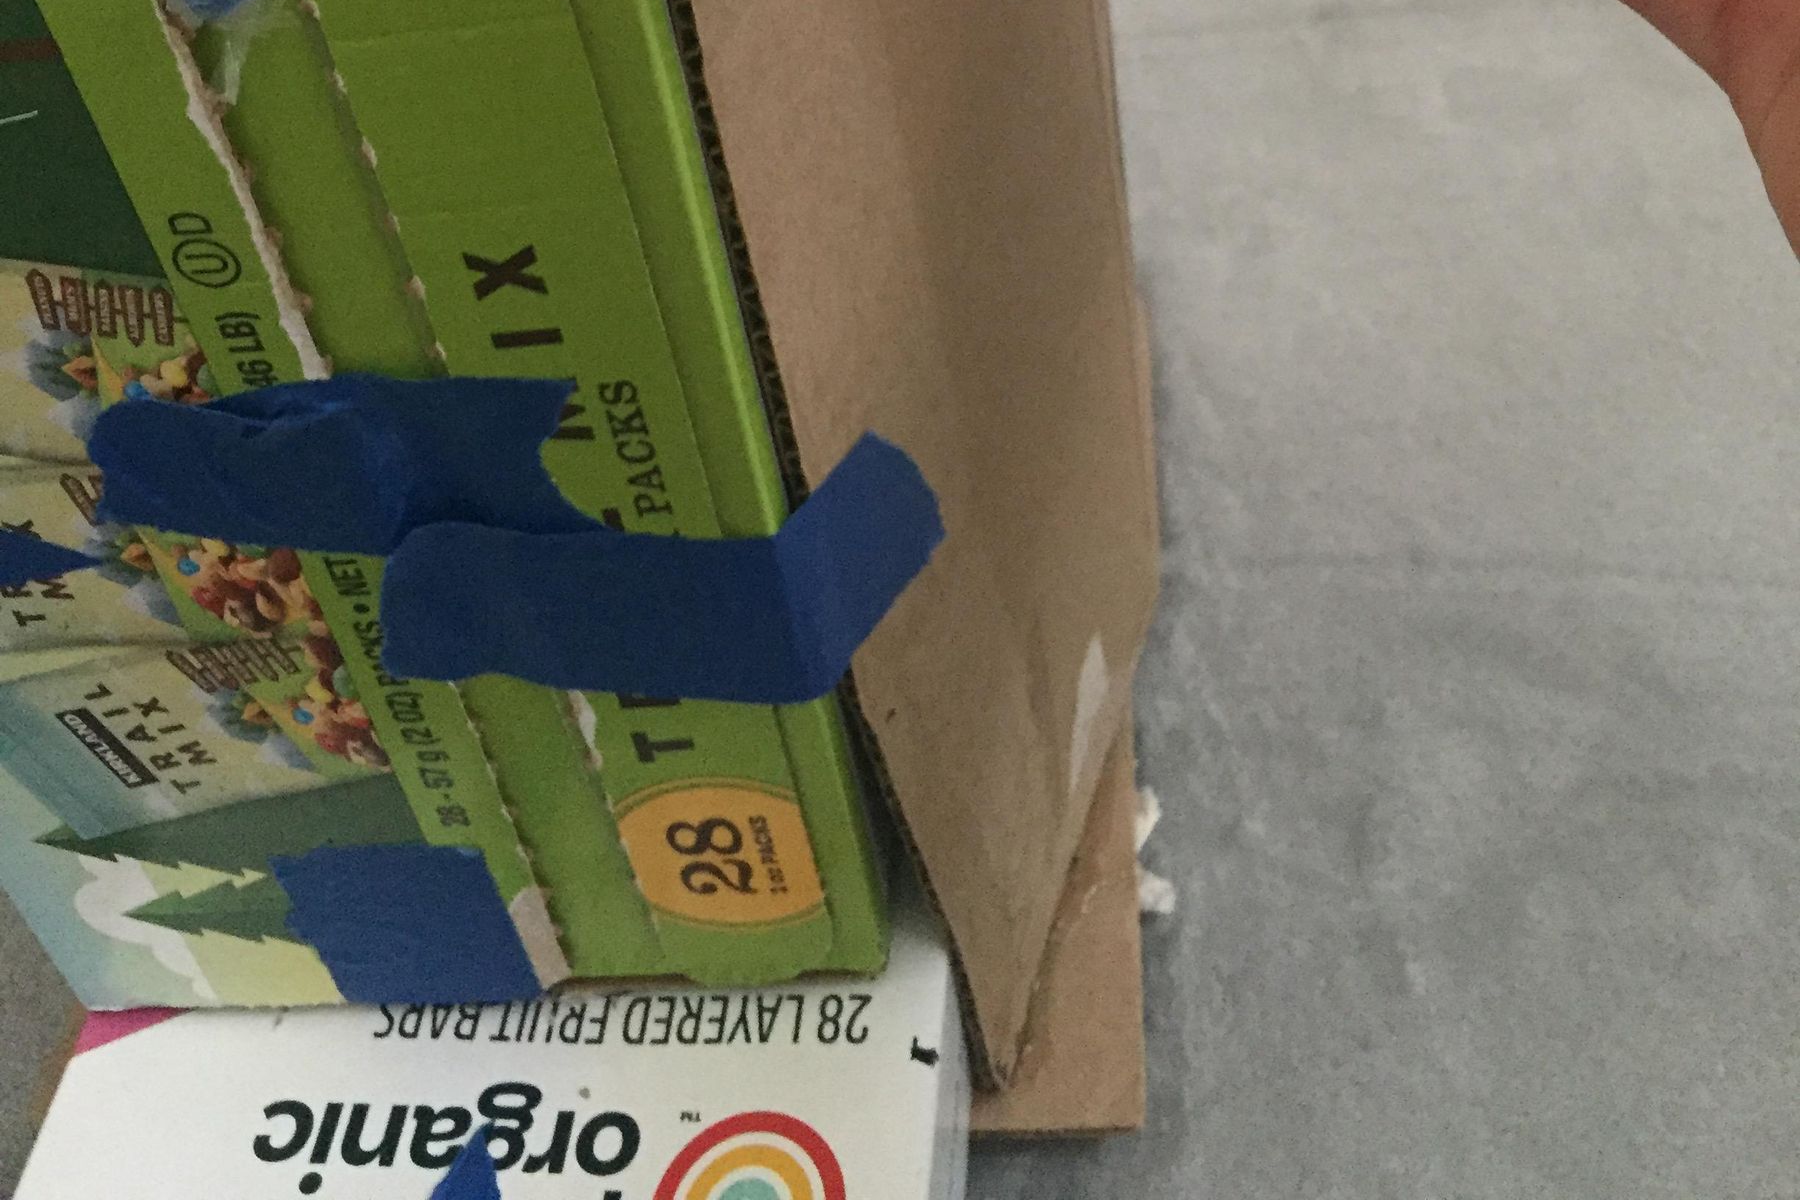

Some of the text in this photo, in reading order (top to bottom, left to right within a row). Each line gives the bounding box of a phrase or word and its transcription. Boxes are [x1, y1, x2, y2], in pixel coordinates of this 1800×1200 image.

[214, 311, 266, 353] LB)
[598, 378, 673, 518] PACKS
[322, 556, 370, 598] NET
[63, 713, 142, 785] KIRKLAND
[84, 682, 201, 794] TRAIL
[133, 697, 218, 767] MIX
[665, 815, 754, 896] 28
[622, 994, 802, 1045] LAYERED
[818, 994, 872, 1045] 28
[252, 1081, 642, 1195] organic
